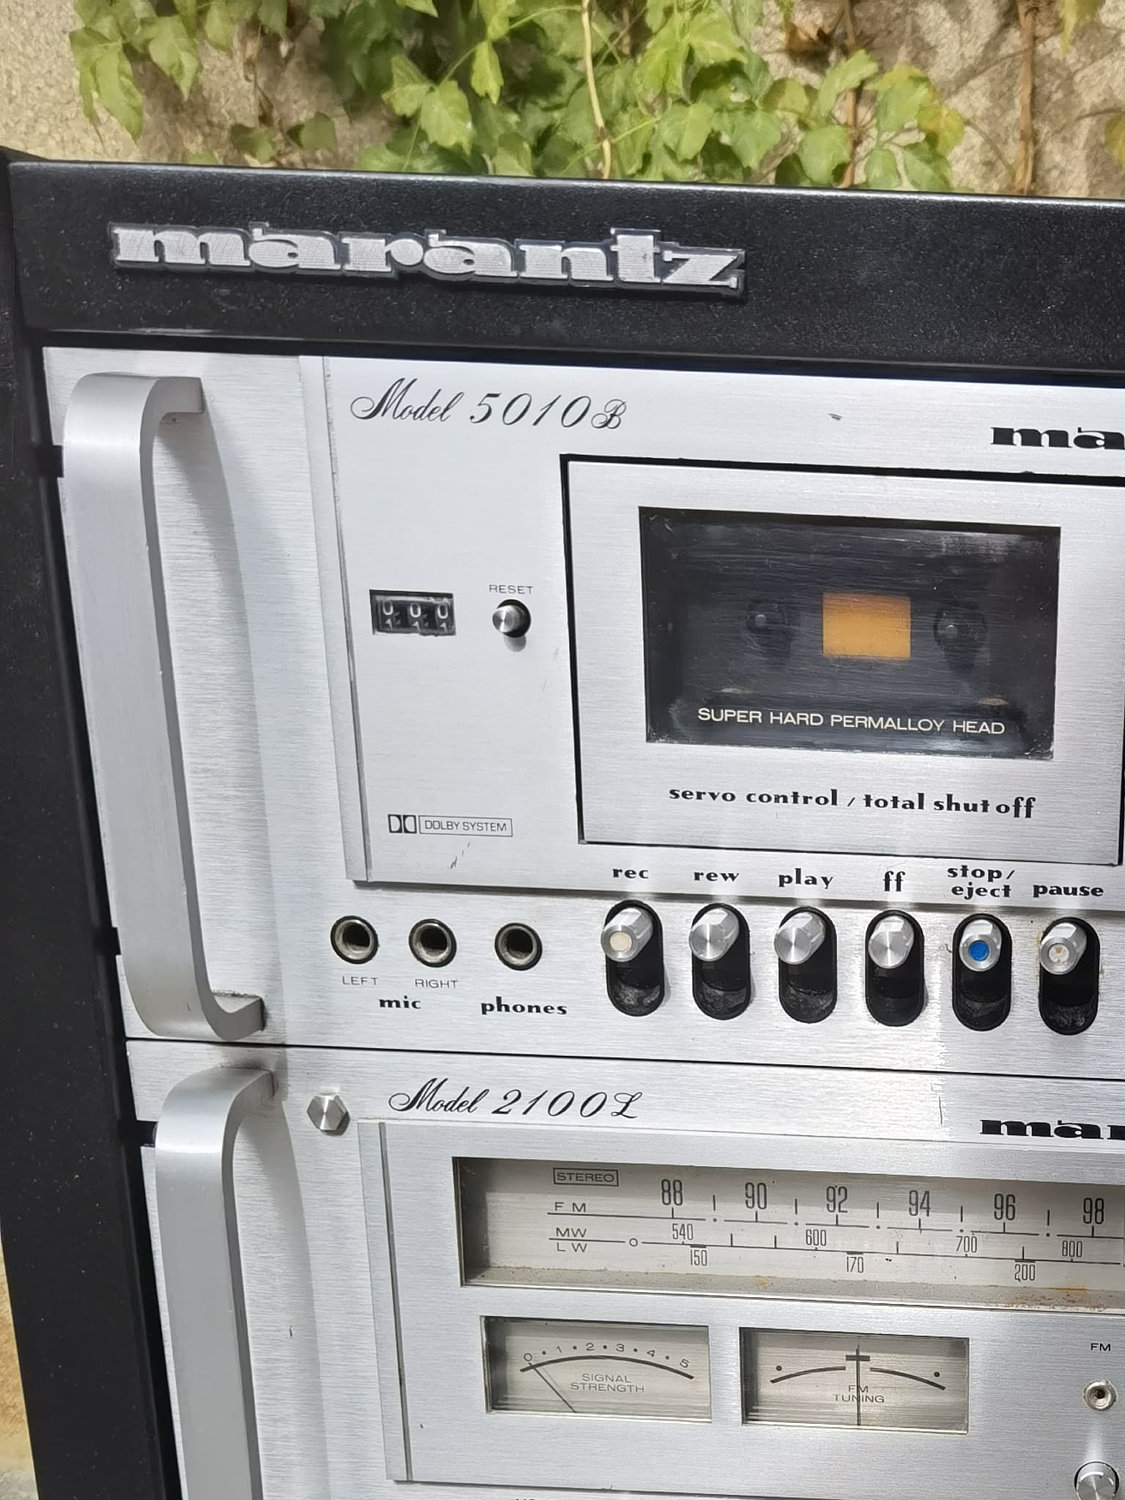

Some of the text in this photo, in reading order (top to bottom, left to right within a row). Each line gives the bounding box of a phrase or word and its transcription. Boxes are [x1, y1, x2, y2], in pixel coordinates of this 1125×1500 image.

[108, 222, 746, 297] marantz
[351, 378, 627, 429] Model 5010B
[489, 584, 534, 595] RESET
[697, 708, 1005, 735] SUPER HARD PERMALLOY HEAD
[669, 788, 736, 803] servo
[746, 789, 838, 806] control
[863, 793, 925, 811] total
[424, 820, 507, 832] DOLBY SYSTEM
[612, 867, 649, 881] rec
[693, 869, 740, 883] rew
[778, 867, 834, 889] play
[883, 870, 906, 893] ff
[951, 880, 1012, 899] eject
[1033, 883, 1104, 899] pause
[342, 976, 378, 986] LEFT
[414, 978, 459, 989] RIGHT
[378, 995, 422, 1010] mic
[480, 996, 568, 1015] phones
[388, 1077, 643, 1119] Model 2100L
[556, 1172, 615, 1183] STEREO
[661, 1179, 683, 1206] 88
[745, 1182, 767, 1210] 90
[826, 1186, 848, 1213] 92
[909, 1190, 931, 1217] 94
[994, 1193, 1016, 1221] 96
[1083, 1197, 1105, 1225] 98
[555, 1228, 587, 1238] MW
[672, 1224, 694, 1241] 540
[805, 1229, 827, 1246] 600
[956, 1236, 978, 1253] 700
[1061, 1241, 1083, 1258] 800
[556, 1243, 587, 1253] LW
[690, 1250, 708, 1266] 150
[846, 1256, 864, 1273] 170
[1014, 1264, 1036, 1281] 200
[1090, 1343, 1111, 1351] FM
[581, 1373, 632, 1384] SIGNAL
[570, 1382, 645, 1394] STRENGTH
[848, 1384, 869, 1393] FM
[833, 1393, 885, 1404] TUNING
